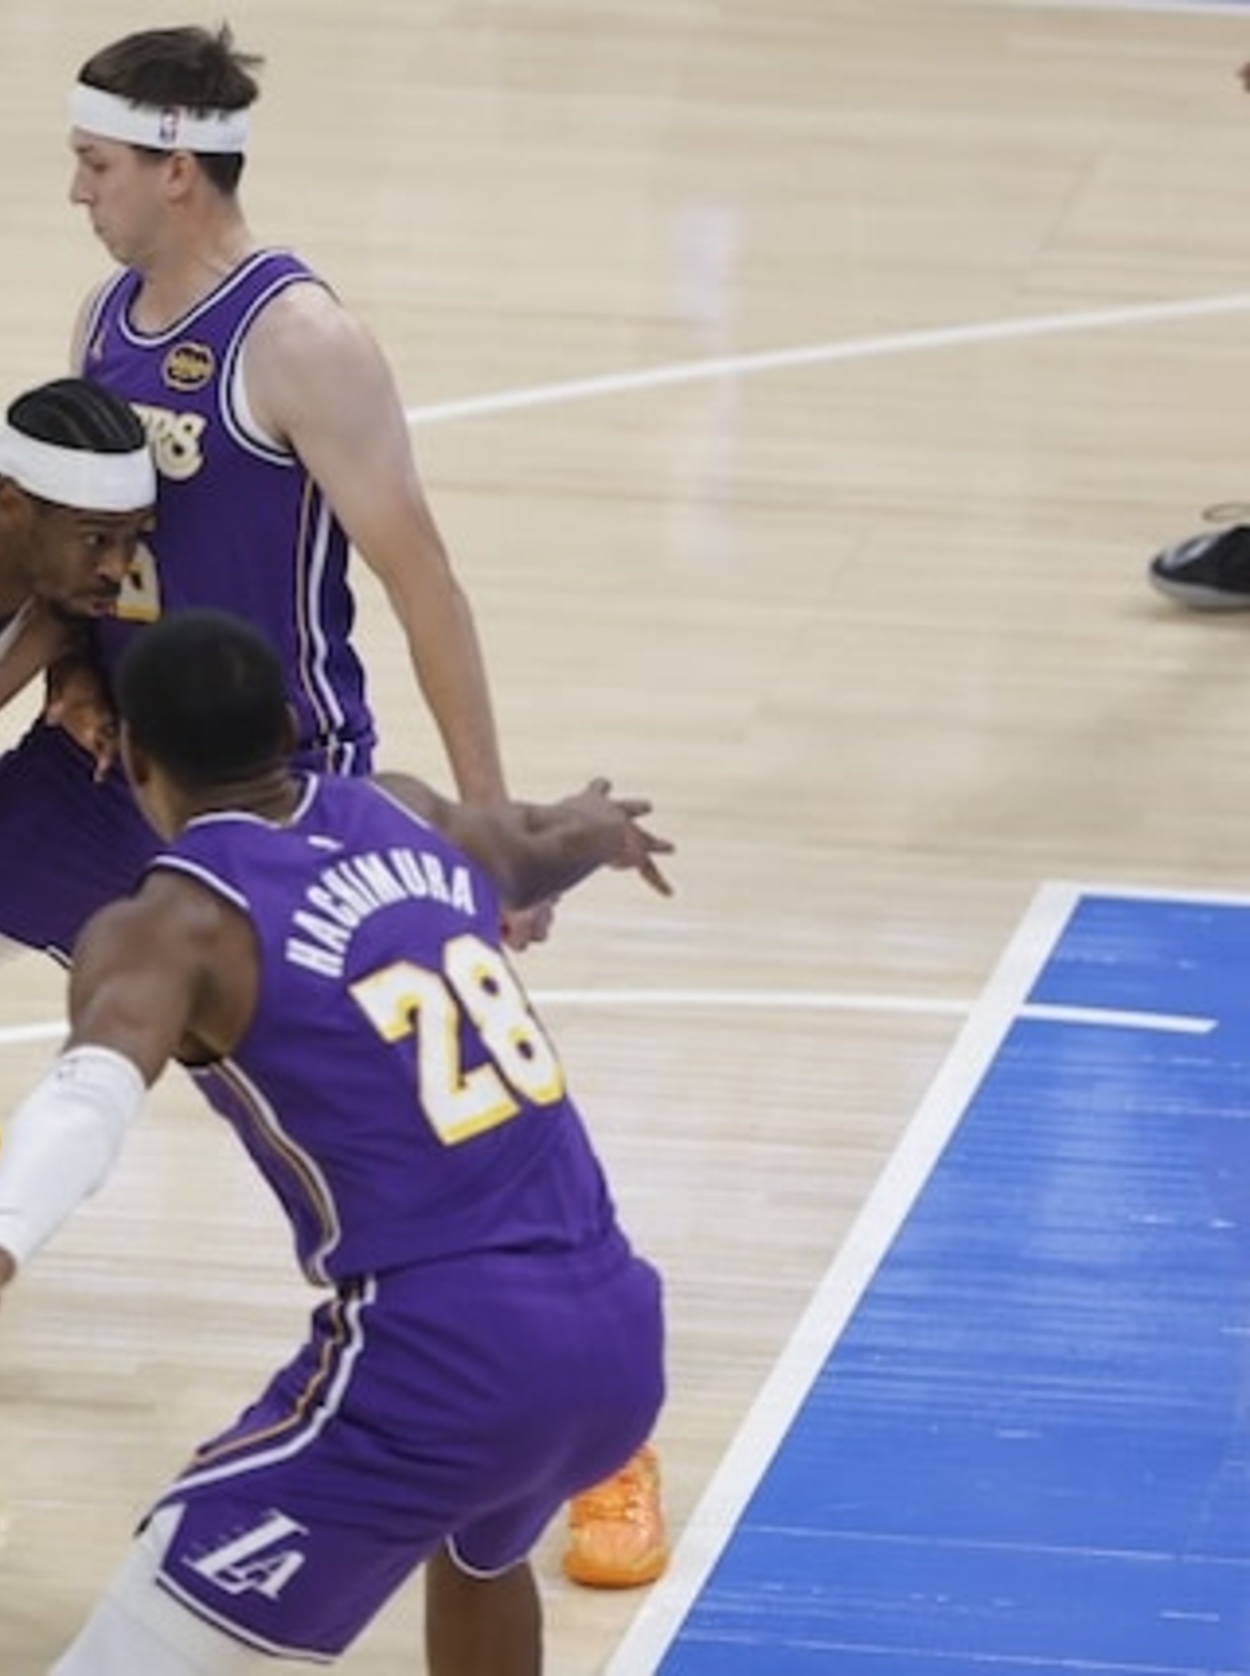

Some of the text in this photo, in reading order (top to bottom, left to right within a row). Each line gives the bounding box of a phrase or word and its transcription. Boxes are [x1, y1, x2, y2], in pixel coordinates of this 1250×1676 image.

[285, 848, 476, 978] HACHIMURA
[348, 933, 565, 1146] 28
[181, 1508, 309, 1601] LA
